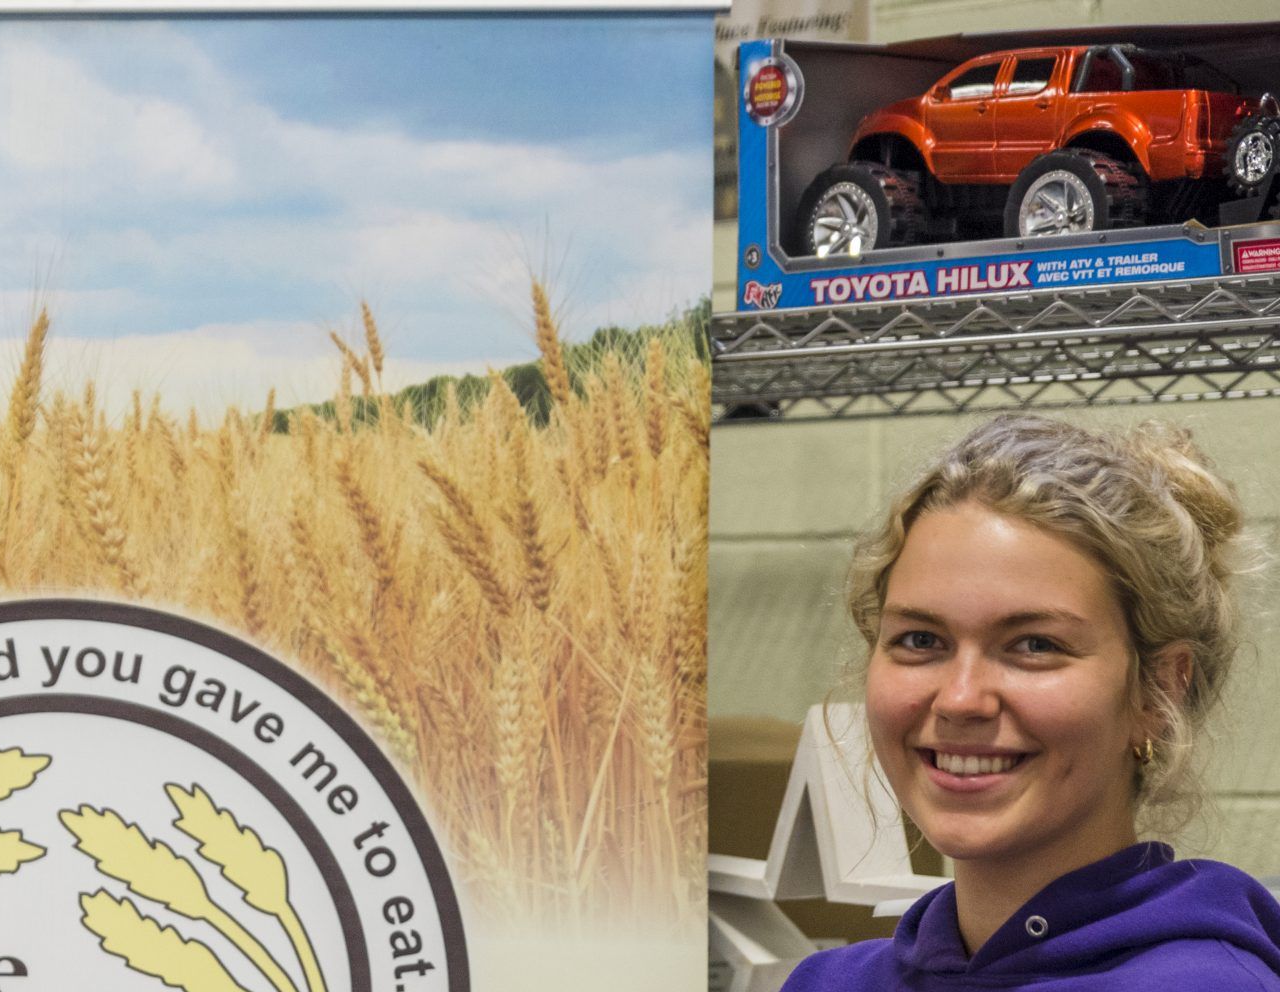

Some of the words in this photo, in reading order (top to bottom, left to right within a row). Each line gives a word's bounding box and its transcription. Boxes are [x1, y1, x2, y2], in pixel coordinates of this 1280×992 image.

[1037, 261, 1067, 272] WITH
[1070, 258, 1092, 269] ATV
[1095, 258, 1104, 267] &
[1108, 253, 1158, 266] TRAILER
[1038, 271, 1069, 283] AVEC
[1072, 269, 1094, 280] VTT
[1097, 267, 1112, 278] ET
[1115, 262, 1185, 277] REMORQUE
[811, 271, 929, 304] TOYOTA
[937, 260, 1033, 293] HILUX
[41, 645, 143, 687] you
[158, 664, 287, 746] gave
[289, 740, 361, 817] me
[352, 819, 399, 879] to
